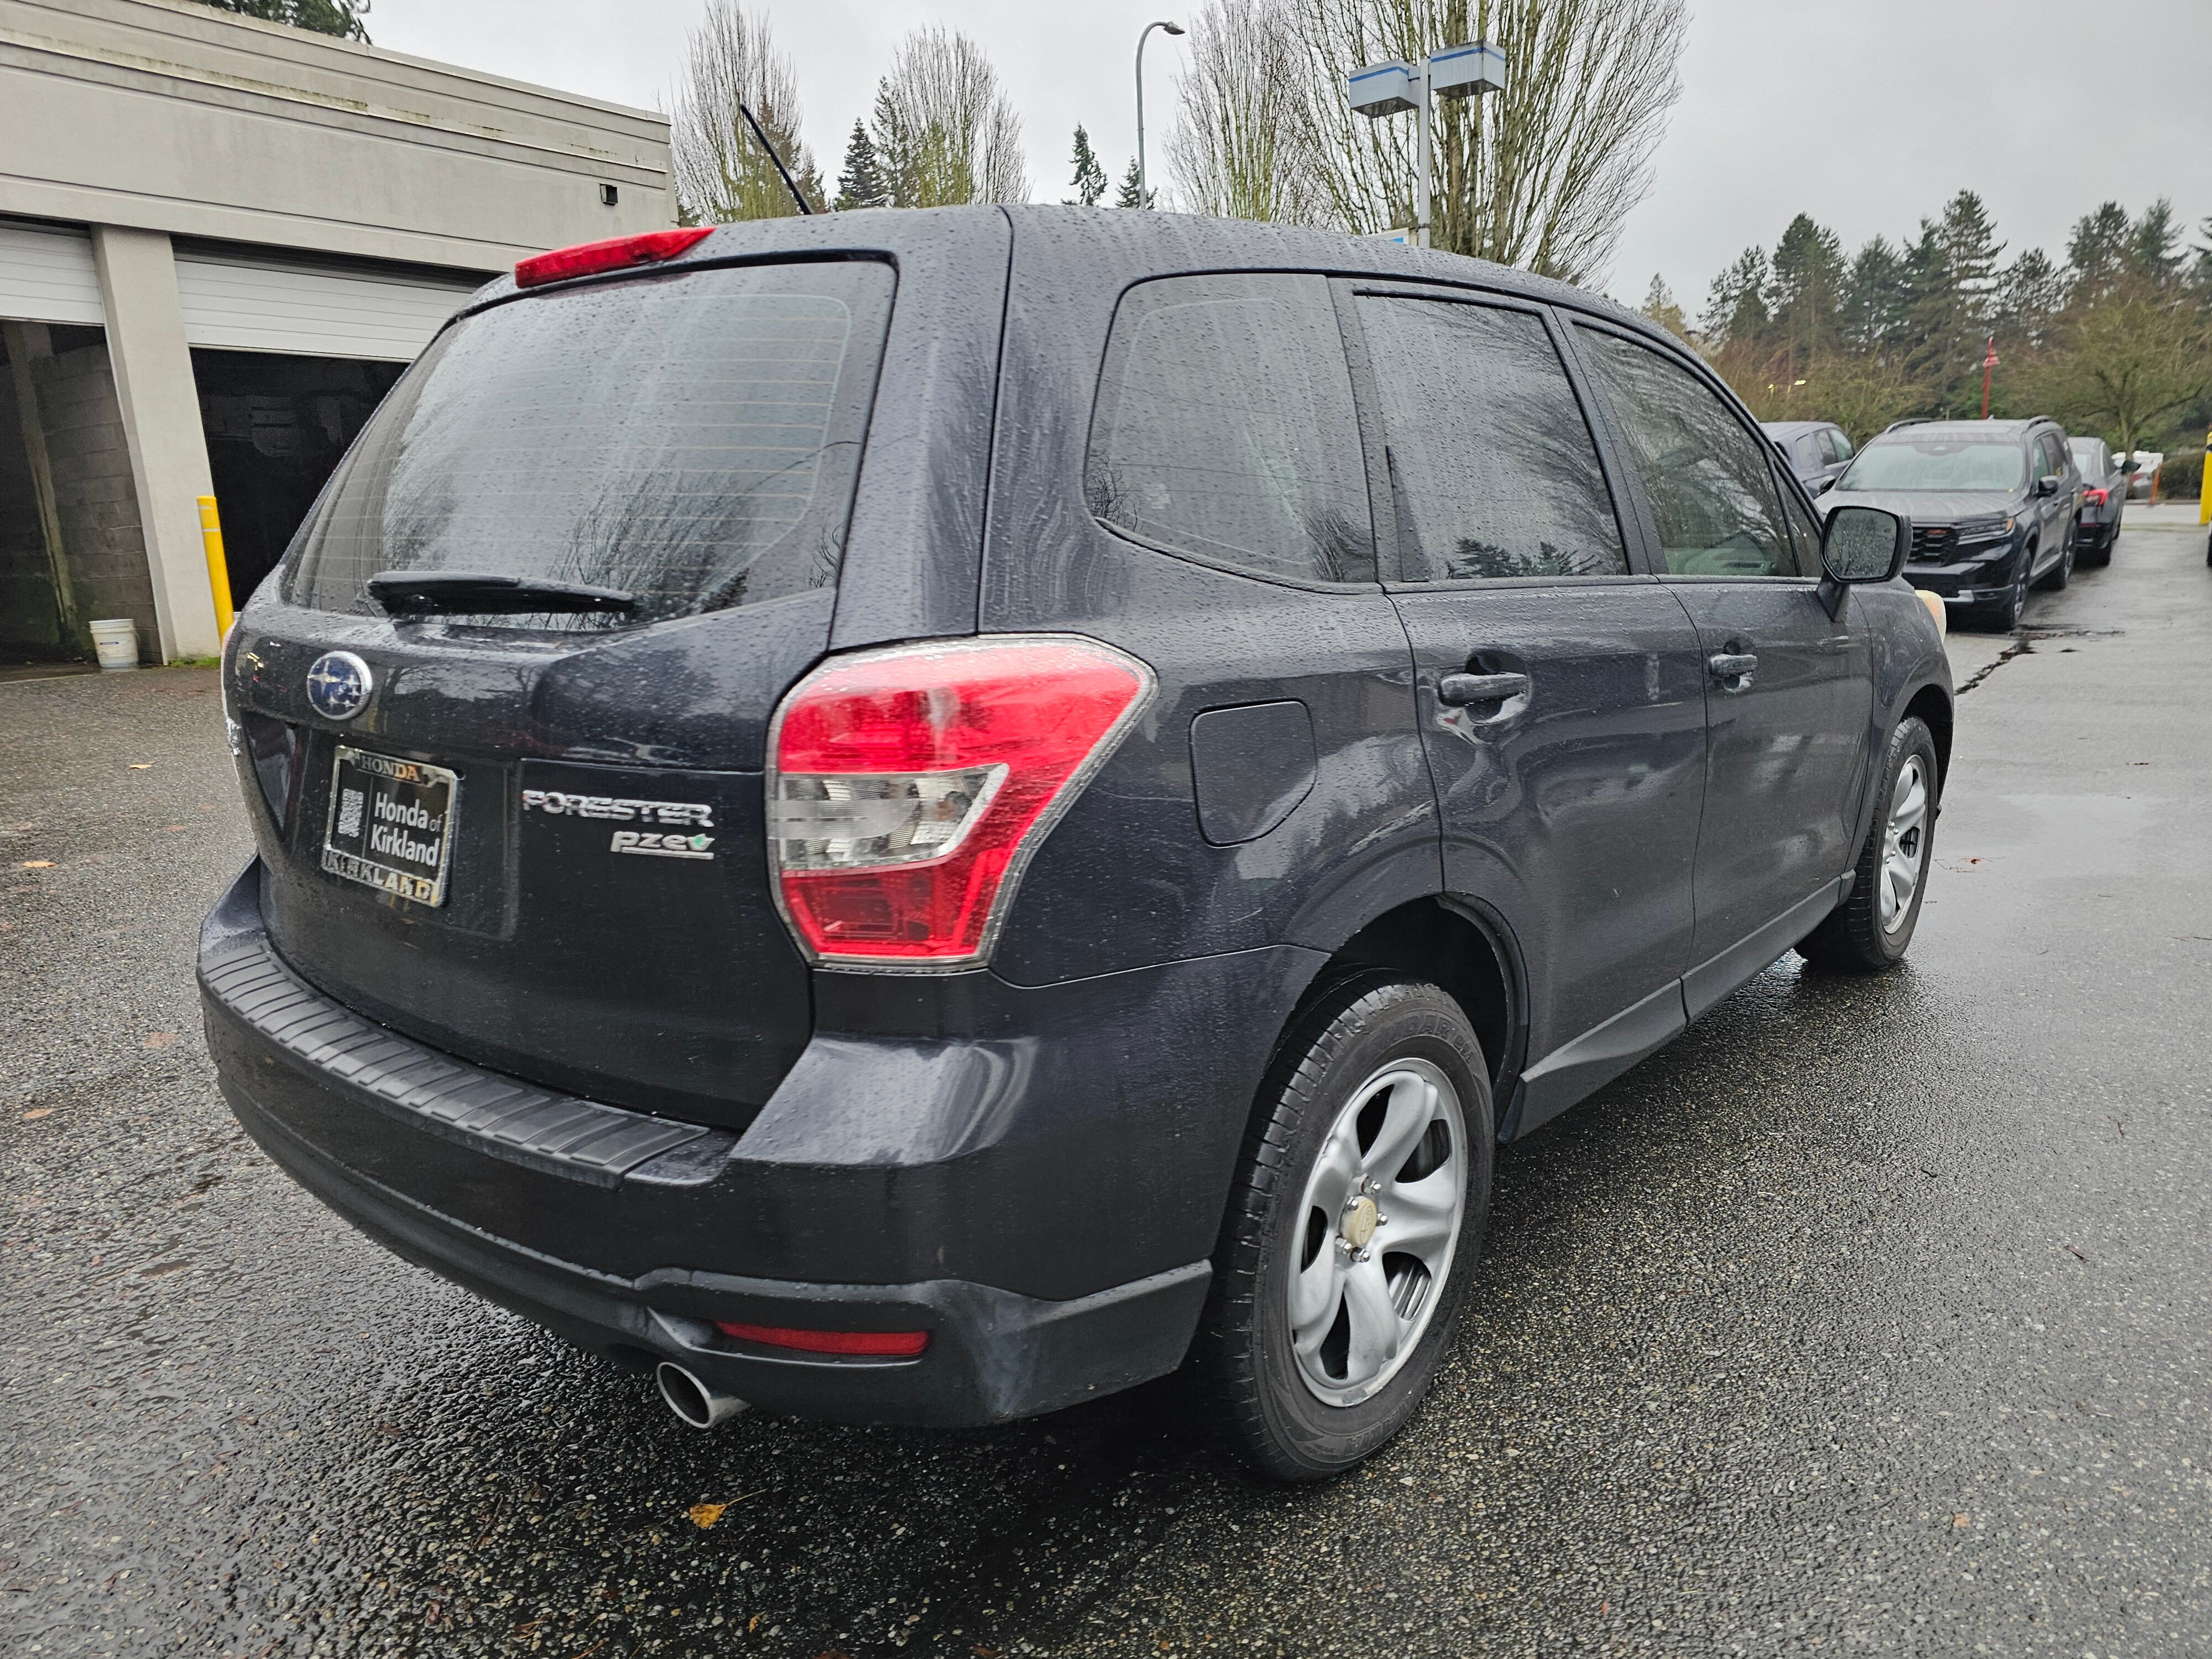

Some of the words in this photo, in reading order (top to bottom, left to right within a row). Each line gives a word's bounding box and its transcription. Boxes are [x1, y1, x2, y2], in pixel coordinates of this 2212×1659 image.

[361, 754, 420, 782] HONDA
[374, 792, 429, 828] Honda
[429, 814, 442, 831] of
[523, 790, 714, 827] FORESTER
[371, 824, 440, 867] Kirkland
[327, 851, 431, 899] KIRKLAND
